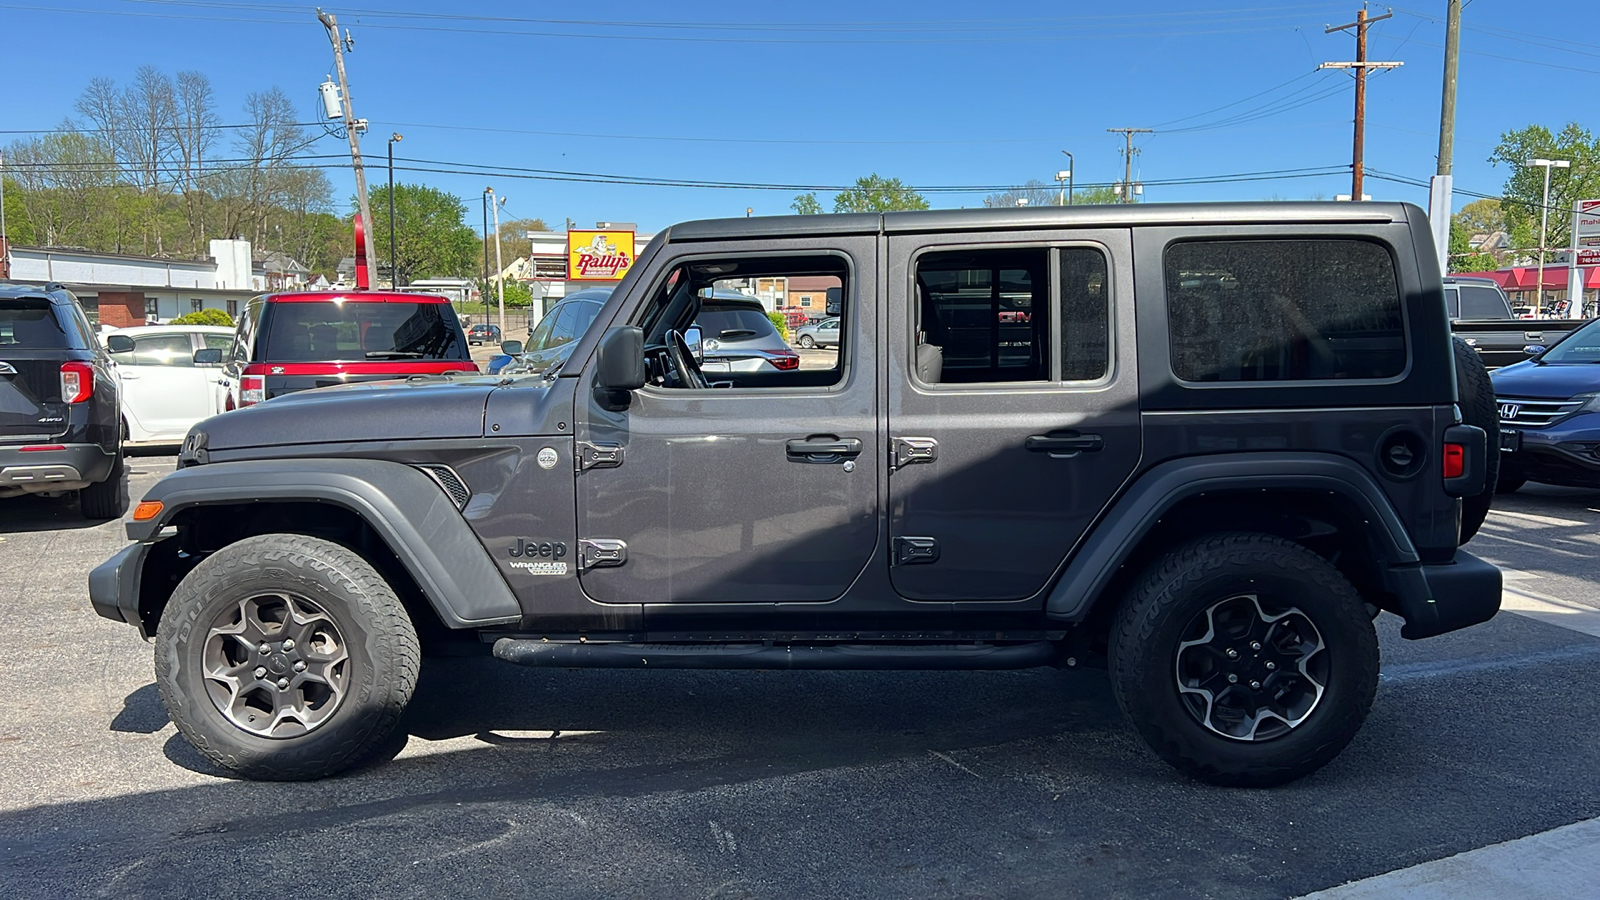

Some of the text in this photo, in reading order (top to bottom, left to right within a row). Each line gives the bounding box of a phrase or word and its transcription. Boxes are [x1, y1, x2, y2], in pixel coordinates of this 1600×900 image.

[576, 251, 630, 276] Rally's
[508, 537, 567, 560] Jeep
[178, 566, 285, 645] DUELER
